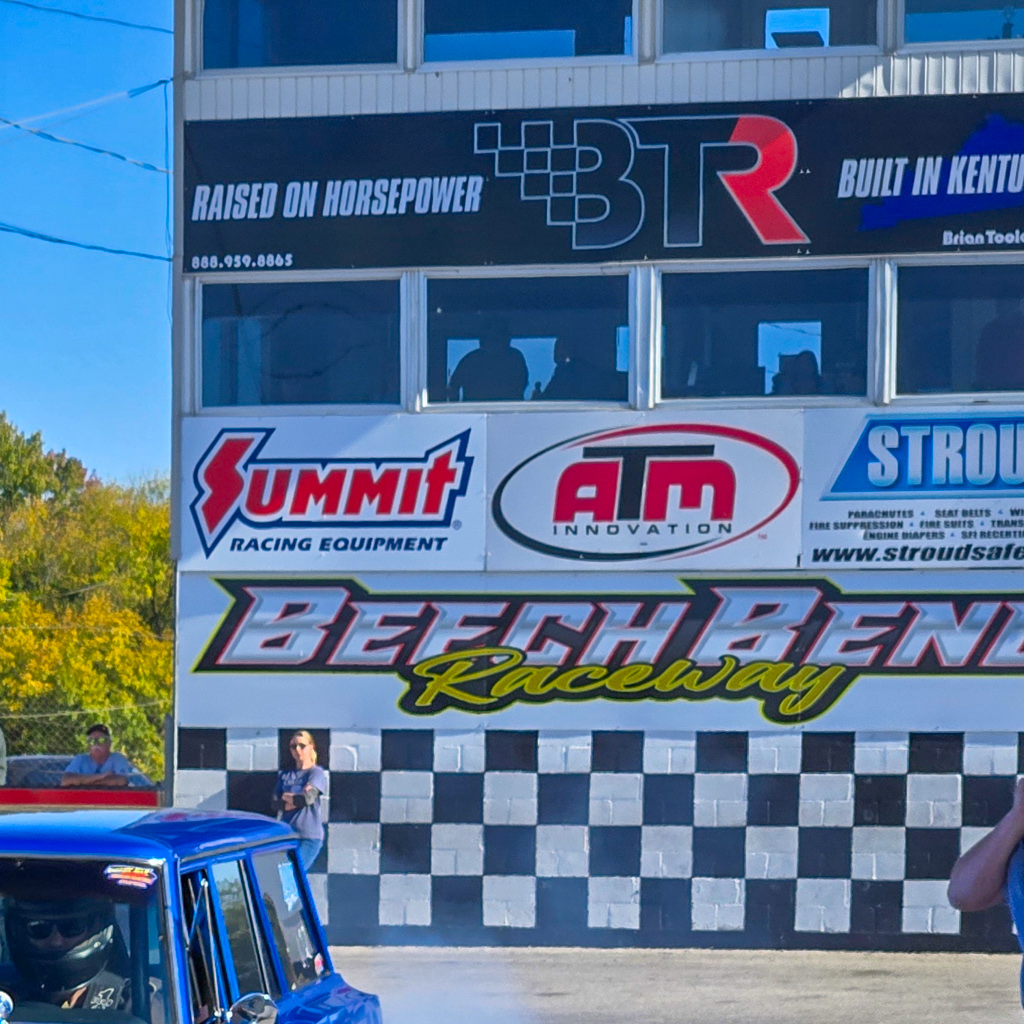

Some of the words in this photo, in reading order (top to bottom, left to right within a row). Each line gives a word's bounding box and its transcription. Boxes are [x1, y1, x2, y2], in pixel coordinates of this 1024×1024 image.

[571, 114, 811, 250] BTR
[837, 157, 909, 199] BUILT
[912, 156, 943, 196] IN
[947, 154, 1024, 194] KENTU
[191, 182, 279, 221] RAISED
[283, 181, 317, 218] ON
[322, 175, 484, 217] HORSEPOWER
[943, 229, 985, 246] Brian
[191, 253, 294, 270] 888.959.8865
[867, 423, 1024, 488] STROU
[848, 510, 914, 519] PARACHUTES
[934, 509, 959, 518] SEAT
[961, 508, 991, 518] BELTS
[552, 523, 733, 536] INNOVATION
[809, 521, 831, 530] FIRE
[833, 520, 904, 530] SUPPRESSION
[919, 520, 941, 529] FIRE
[943, 520, 974, 529] SUITS
[863, 531, 899, 540] ENGINE
[901, 530, 946, 540] DIAPERS
[979, 530, 1024, 539] RECERTI
[230, 537, 312, 552] RACING
[318, 536, 448, 552] EQUIPMENT
[413, 648, 846, 716] Raceway
